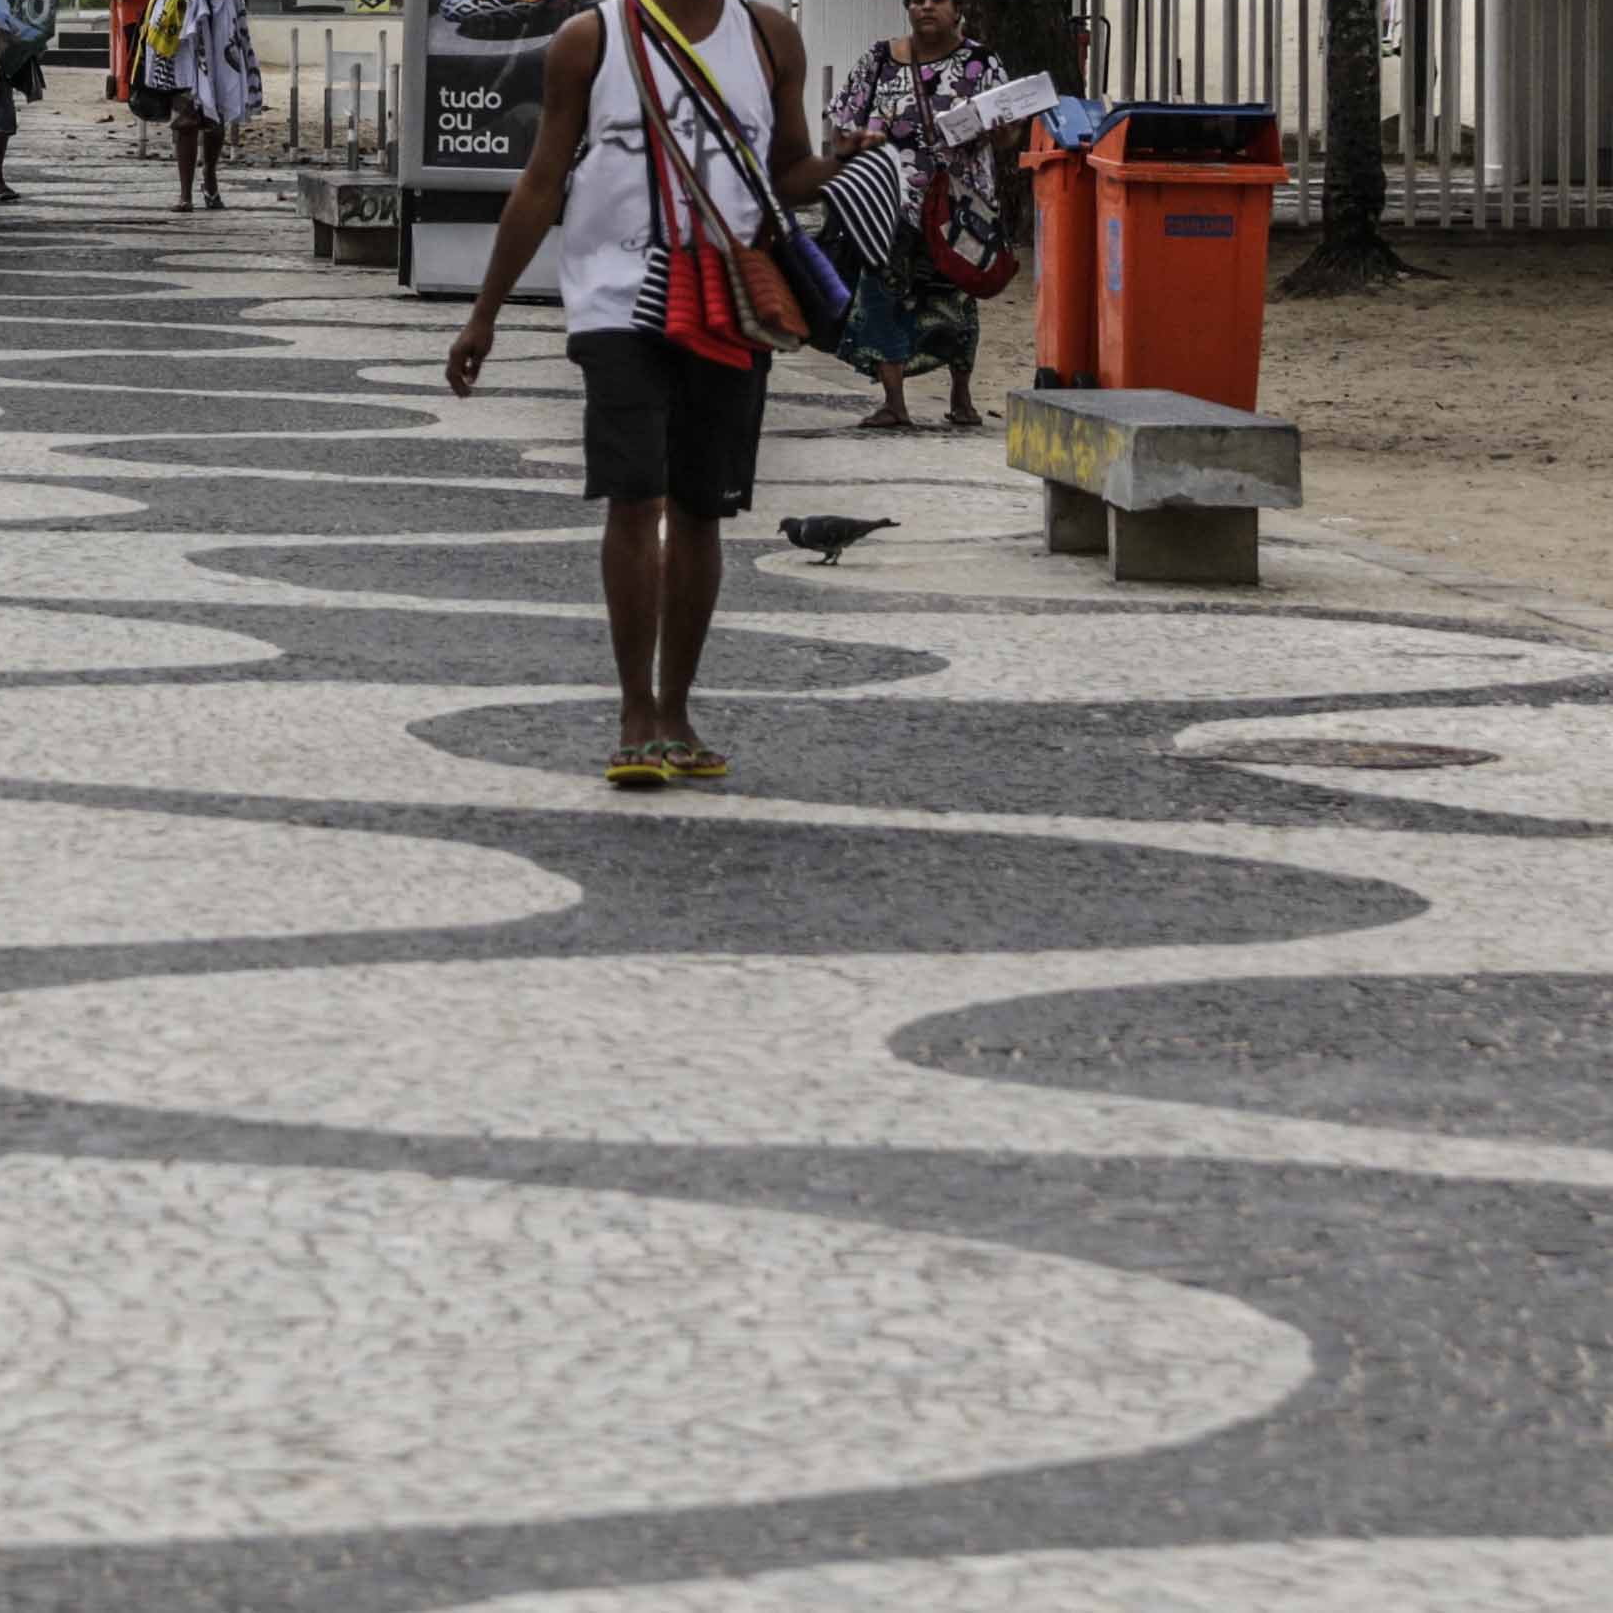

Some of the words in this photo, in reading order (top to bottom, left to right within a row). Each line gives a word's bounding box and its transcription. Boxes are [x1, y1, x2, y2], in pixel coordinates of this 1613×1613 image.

[438, 86, 502, 109] tudo
[439, 112, 473, 130] ou
[438, 131, 510, 154] nada
